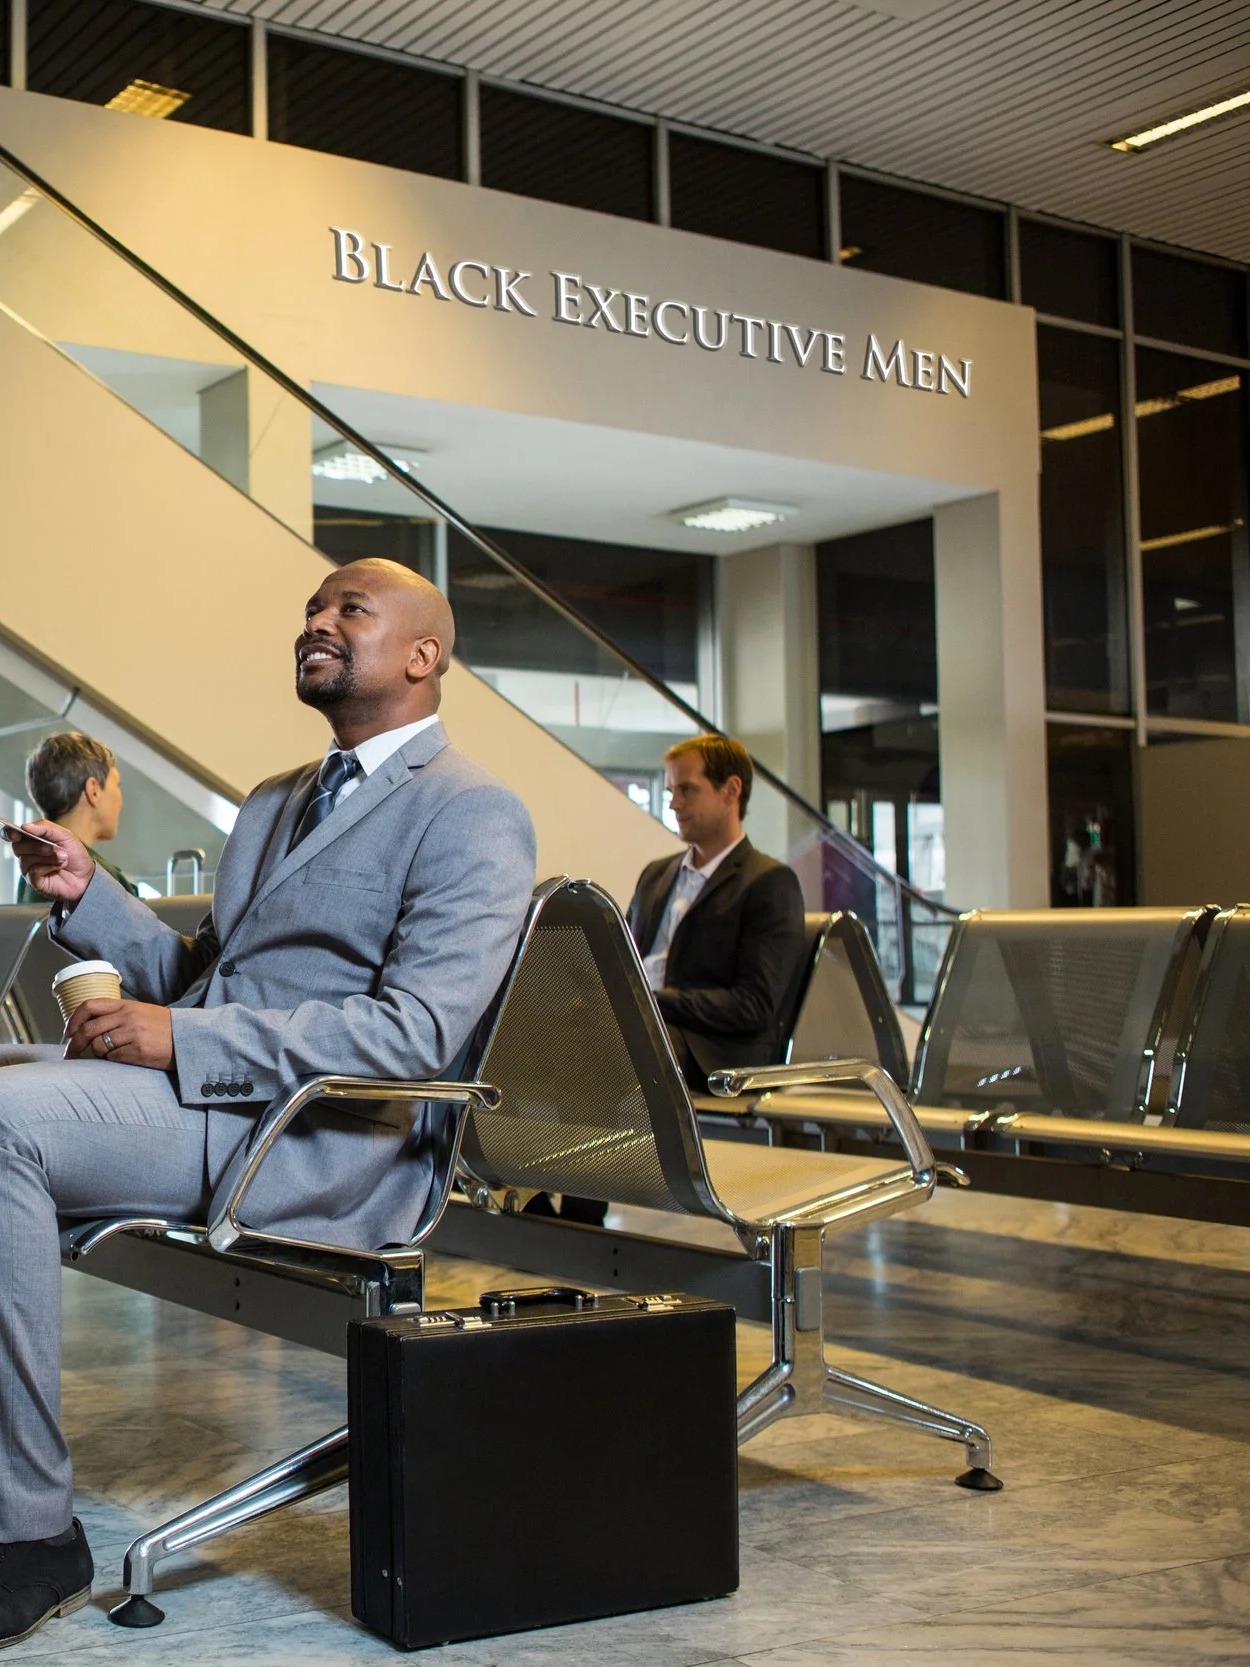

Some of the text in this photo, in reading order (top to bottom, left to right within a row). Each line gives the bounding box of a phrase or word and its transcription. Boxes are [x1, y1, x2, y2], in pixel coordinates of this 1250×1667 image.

[329, 226, 973, 398] BLACK EXECUTIVE MEN
